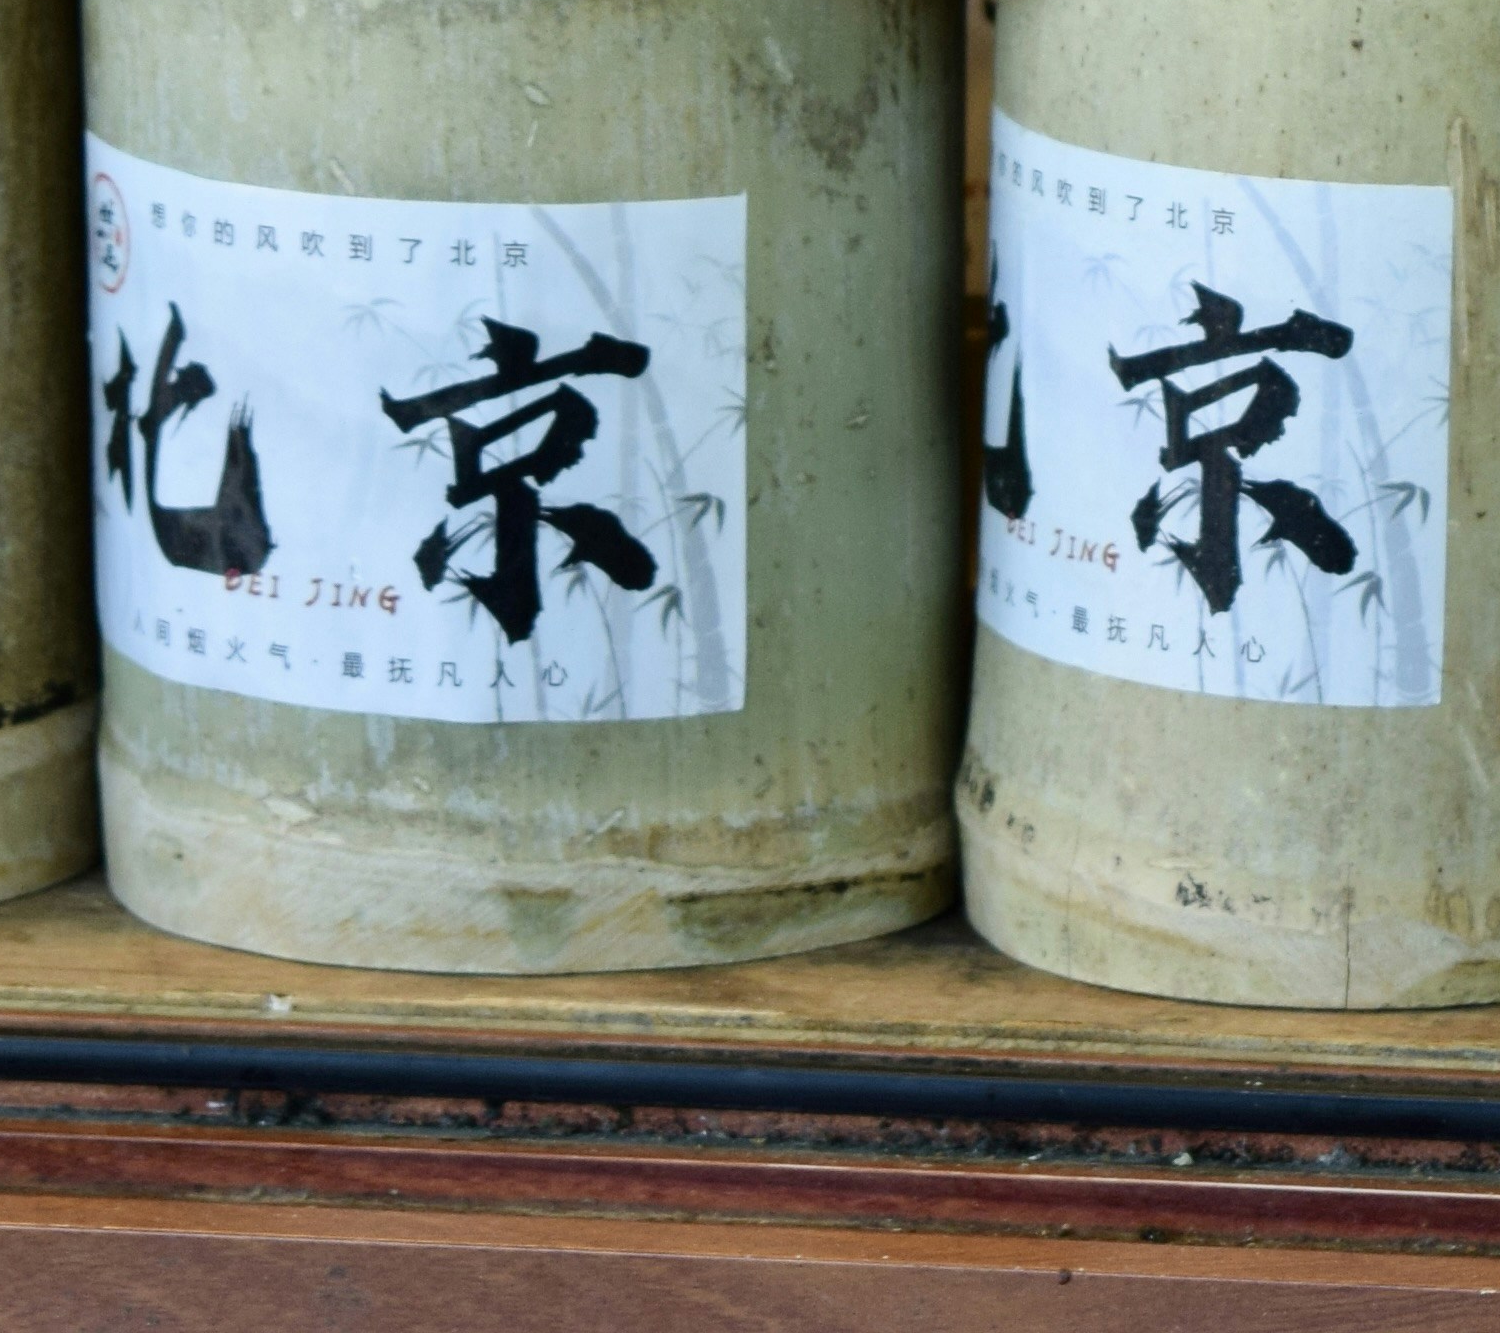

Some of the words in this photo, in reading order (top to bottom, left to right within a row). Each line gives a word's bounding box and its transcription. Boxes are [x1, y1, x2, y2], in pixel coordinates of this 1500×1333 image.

[103, 300, 656, 646] 北京
[1049, 529, 1120, 571] JING
[223, 568, 280, 597] BEI
[305, 579, 401, 613] JING
